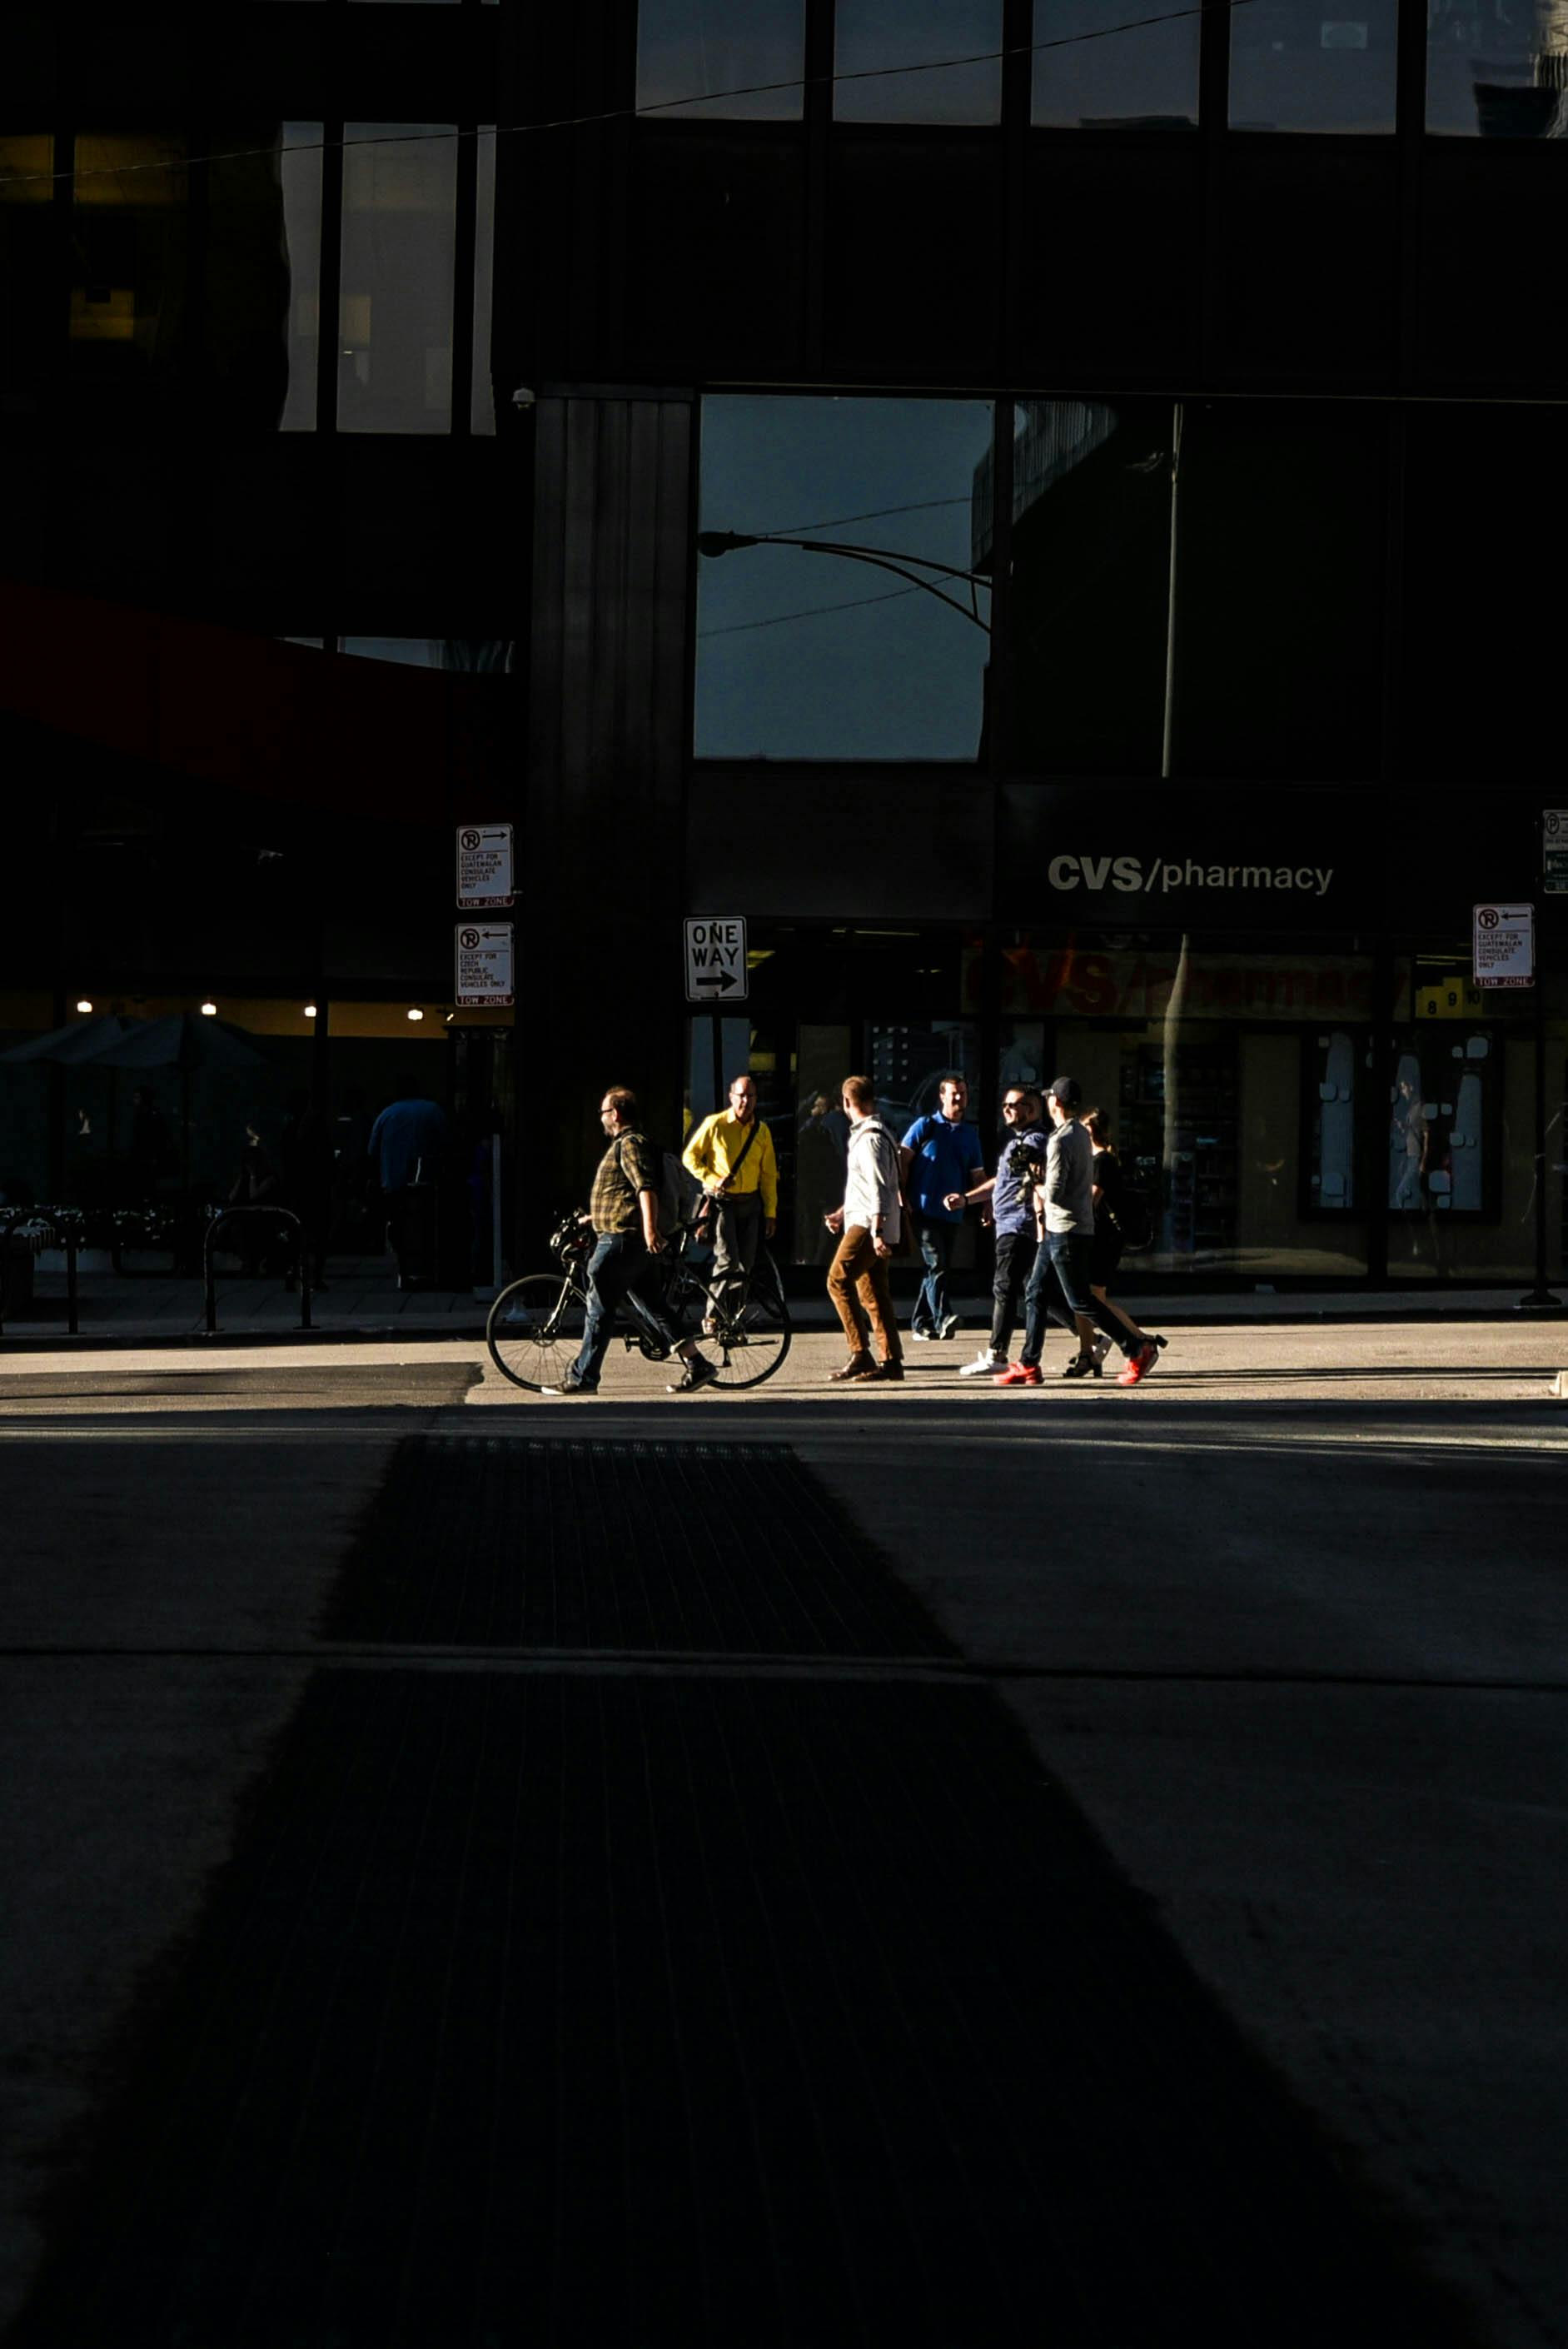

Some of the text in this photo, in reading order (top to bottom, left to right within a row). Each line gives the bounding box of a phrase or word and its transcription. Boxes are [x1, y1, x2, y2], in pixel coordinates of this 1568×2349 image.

[1048, 855, 1333, 895] CVS/pharmacy
[461, 897, 508, 907] TOW ZONE
[693, 925, 739, 944] ONE
[691, 947, 739, 966] WAY
[1479, 978, 1498, 986] TOW
[460, 995, 509, 1005] TOW ZONE
[1448, 992, 1457, 1006] 9
[1427, 1000, 1437, 1015] 8
